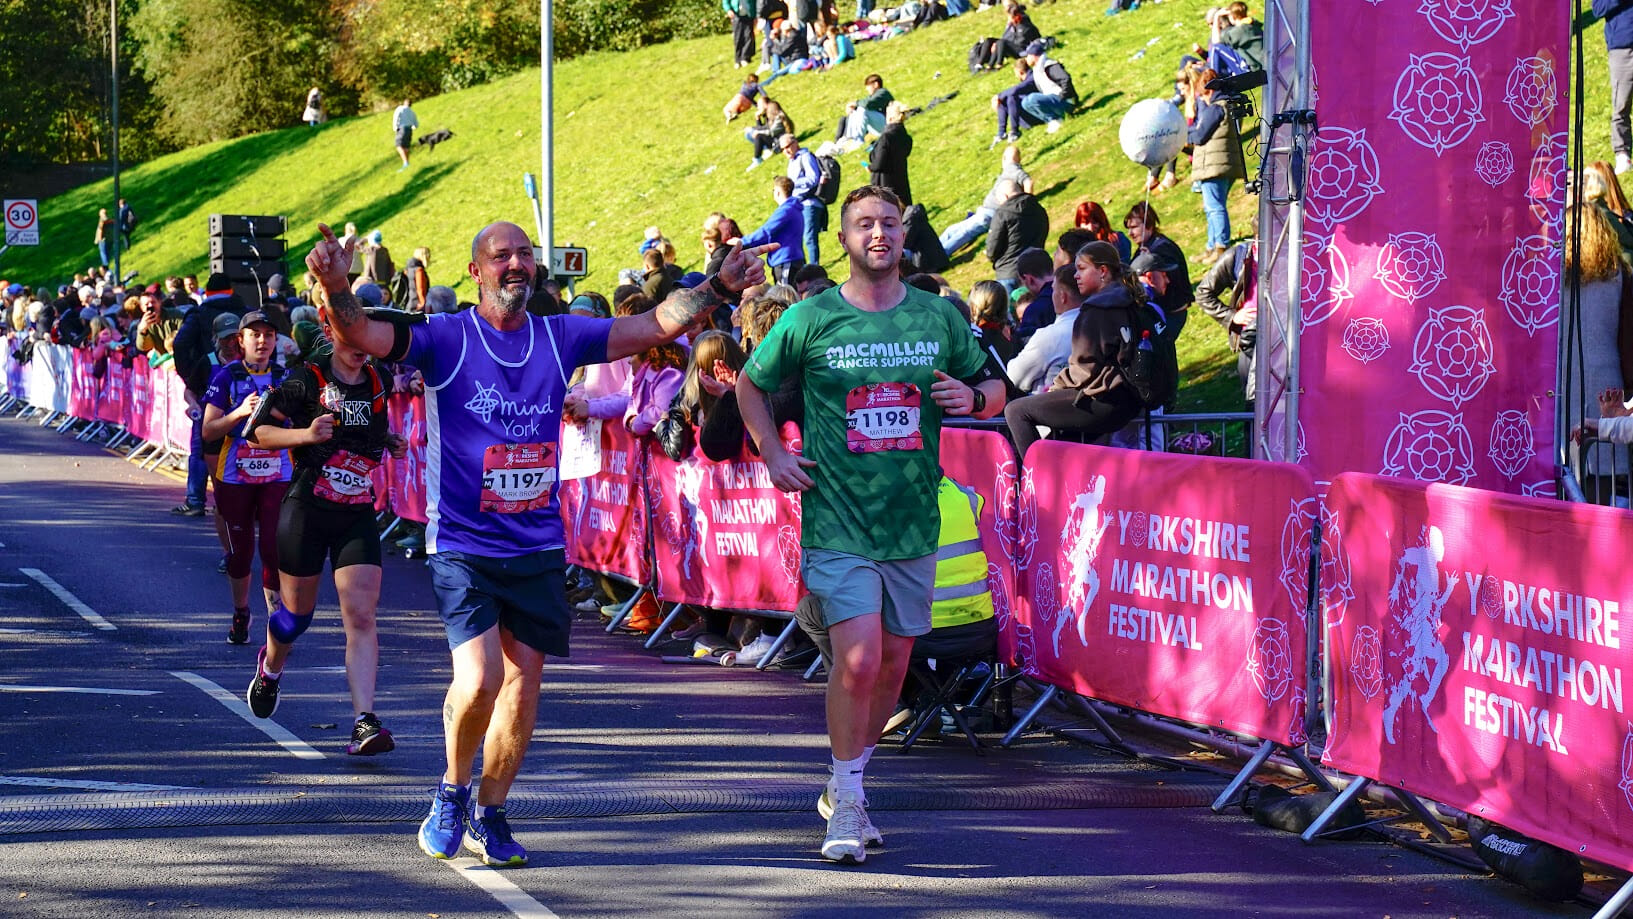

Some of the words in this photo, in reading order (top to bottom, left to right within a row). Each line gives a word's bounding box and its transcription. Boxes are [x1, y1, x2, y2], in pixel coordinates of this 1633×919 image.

[11, 210, 31, 221] 30
[825, 341, 940, 360] MACMILLAN
[828, 359, 878, 369] CANCER
[881, 355, 934, 368] SUPPORT
[500, 418, 539, 437] York
[862, 411, 909, 427] 1198
[869, 428, 904, 436] MATTHEW
[249, 461, 270, 470] 686
[483, 480, 492, 489] M
[500, 473, 544, 489] 1197
[711, 498, 777, 524] MARATHON
[715, 531, 759, 556] FESTIVAL
[1110, 558, 1254, 613] MARATHON
[1108, 603, 1203, 651] FESTIVAL
[1462, 631, 1624, 713] MARATHON
[1464, 686, 1568, 756] FESTIVAL
